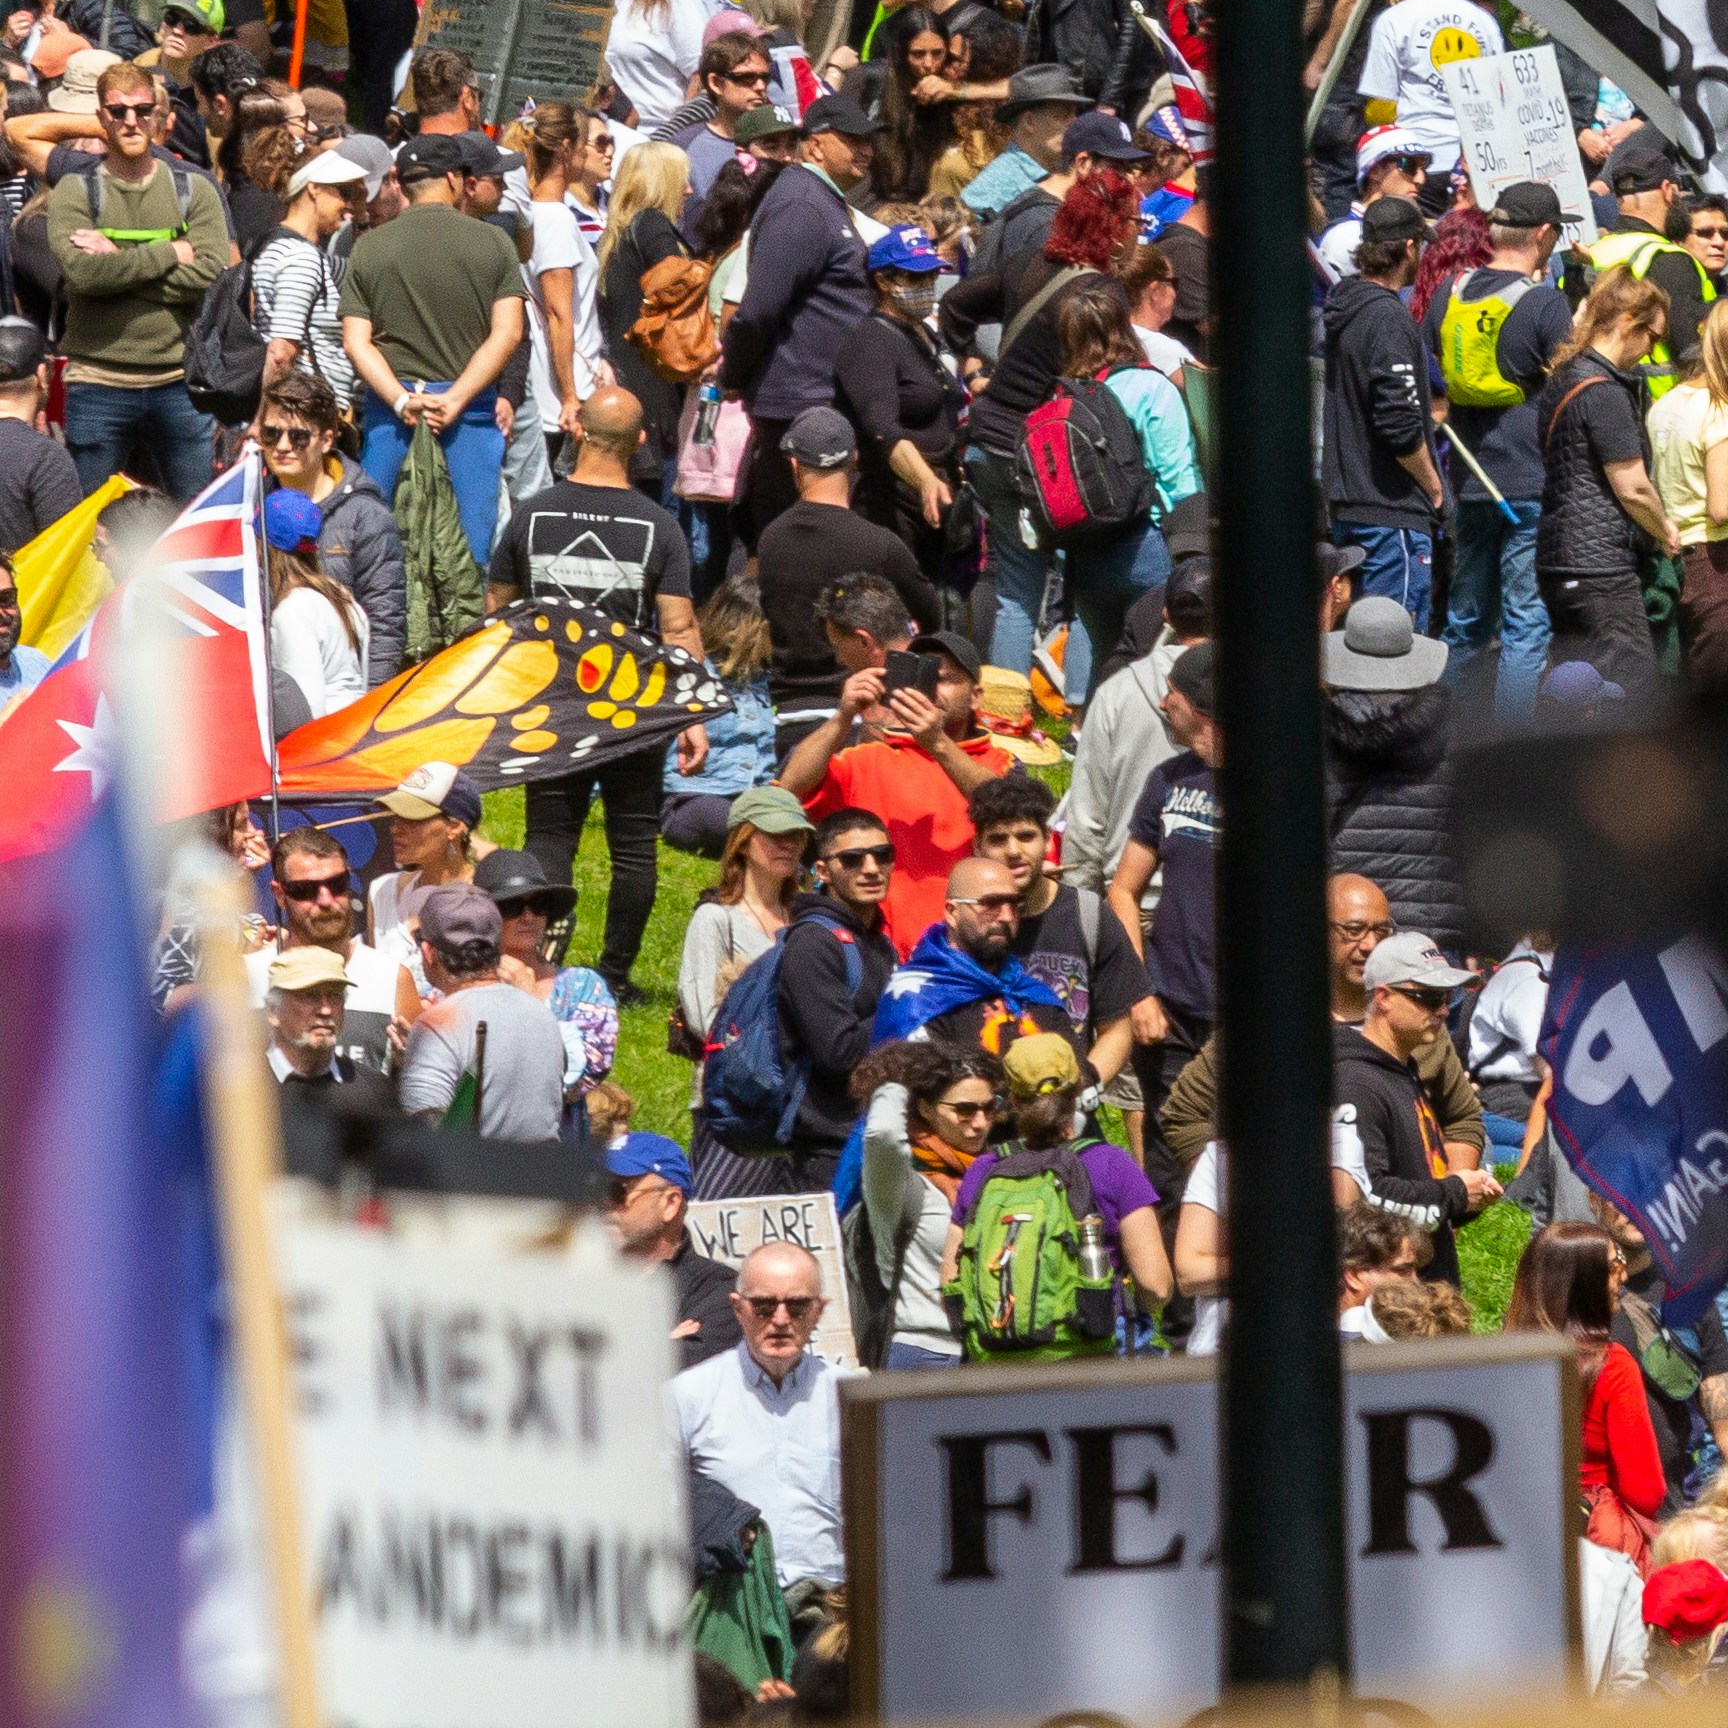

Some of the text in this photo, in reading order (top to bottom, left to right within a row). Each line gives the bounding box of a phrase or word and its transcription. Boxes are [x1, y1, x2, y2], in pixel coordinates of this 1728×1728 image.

[1513, 52, 1540, 85] 633
[1523, 129, 1560, 146] VACCINES
[572, 511, 610, 522] SILENT
[694, 1202, 823, 1259] WE ARE
[375, 1292, 614, 1454] NEXT
[935, 1403, 1505, 1586] FER
[312, 1500, 692, 1654] ANDEMIC
